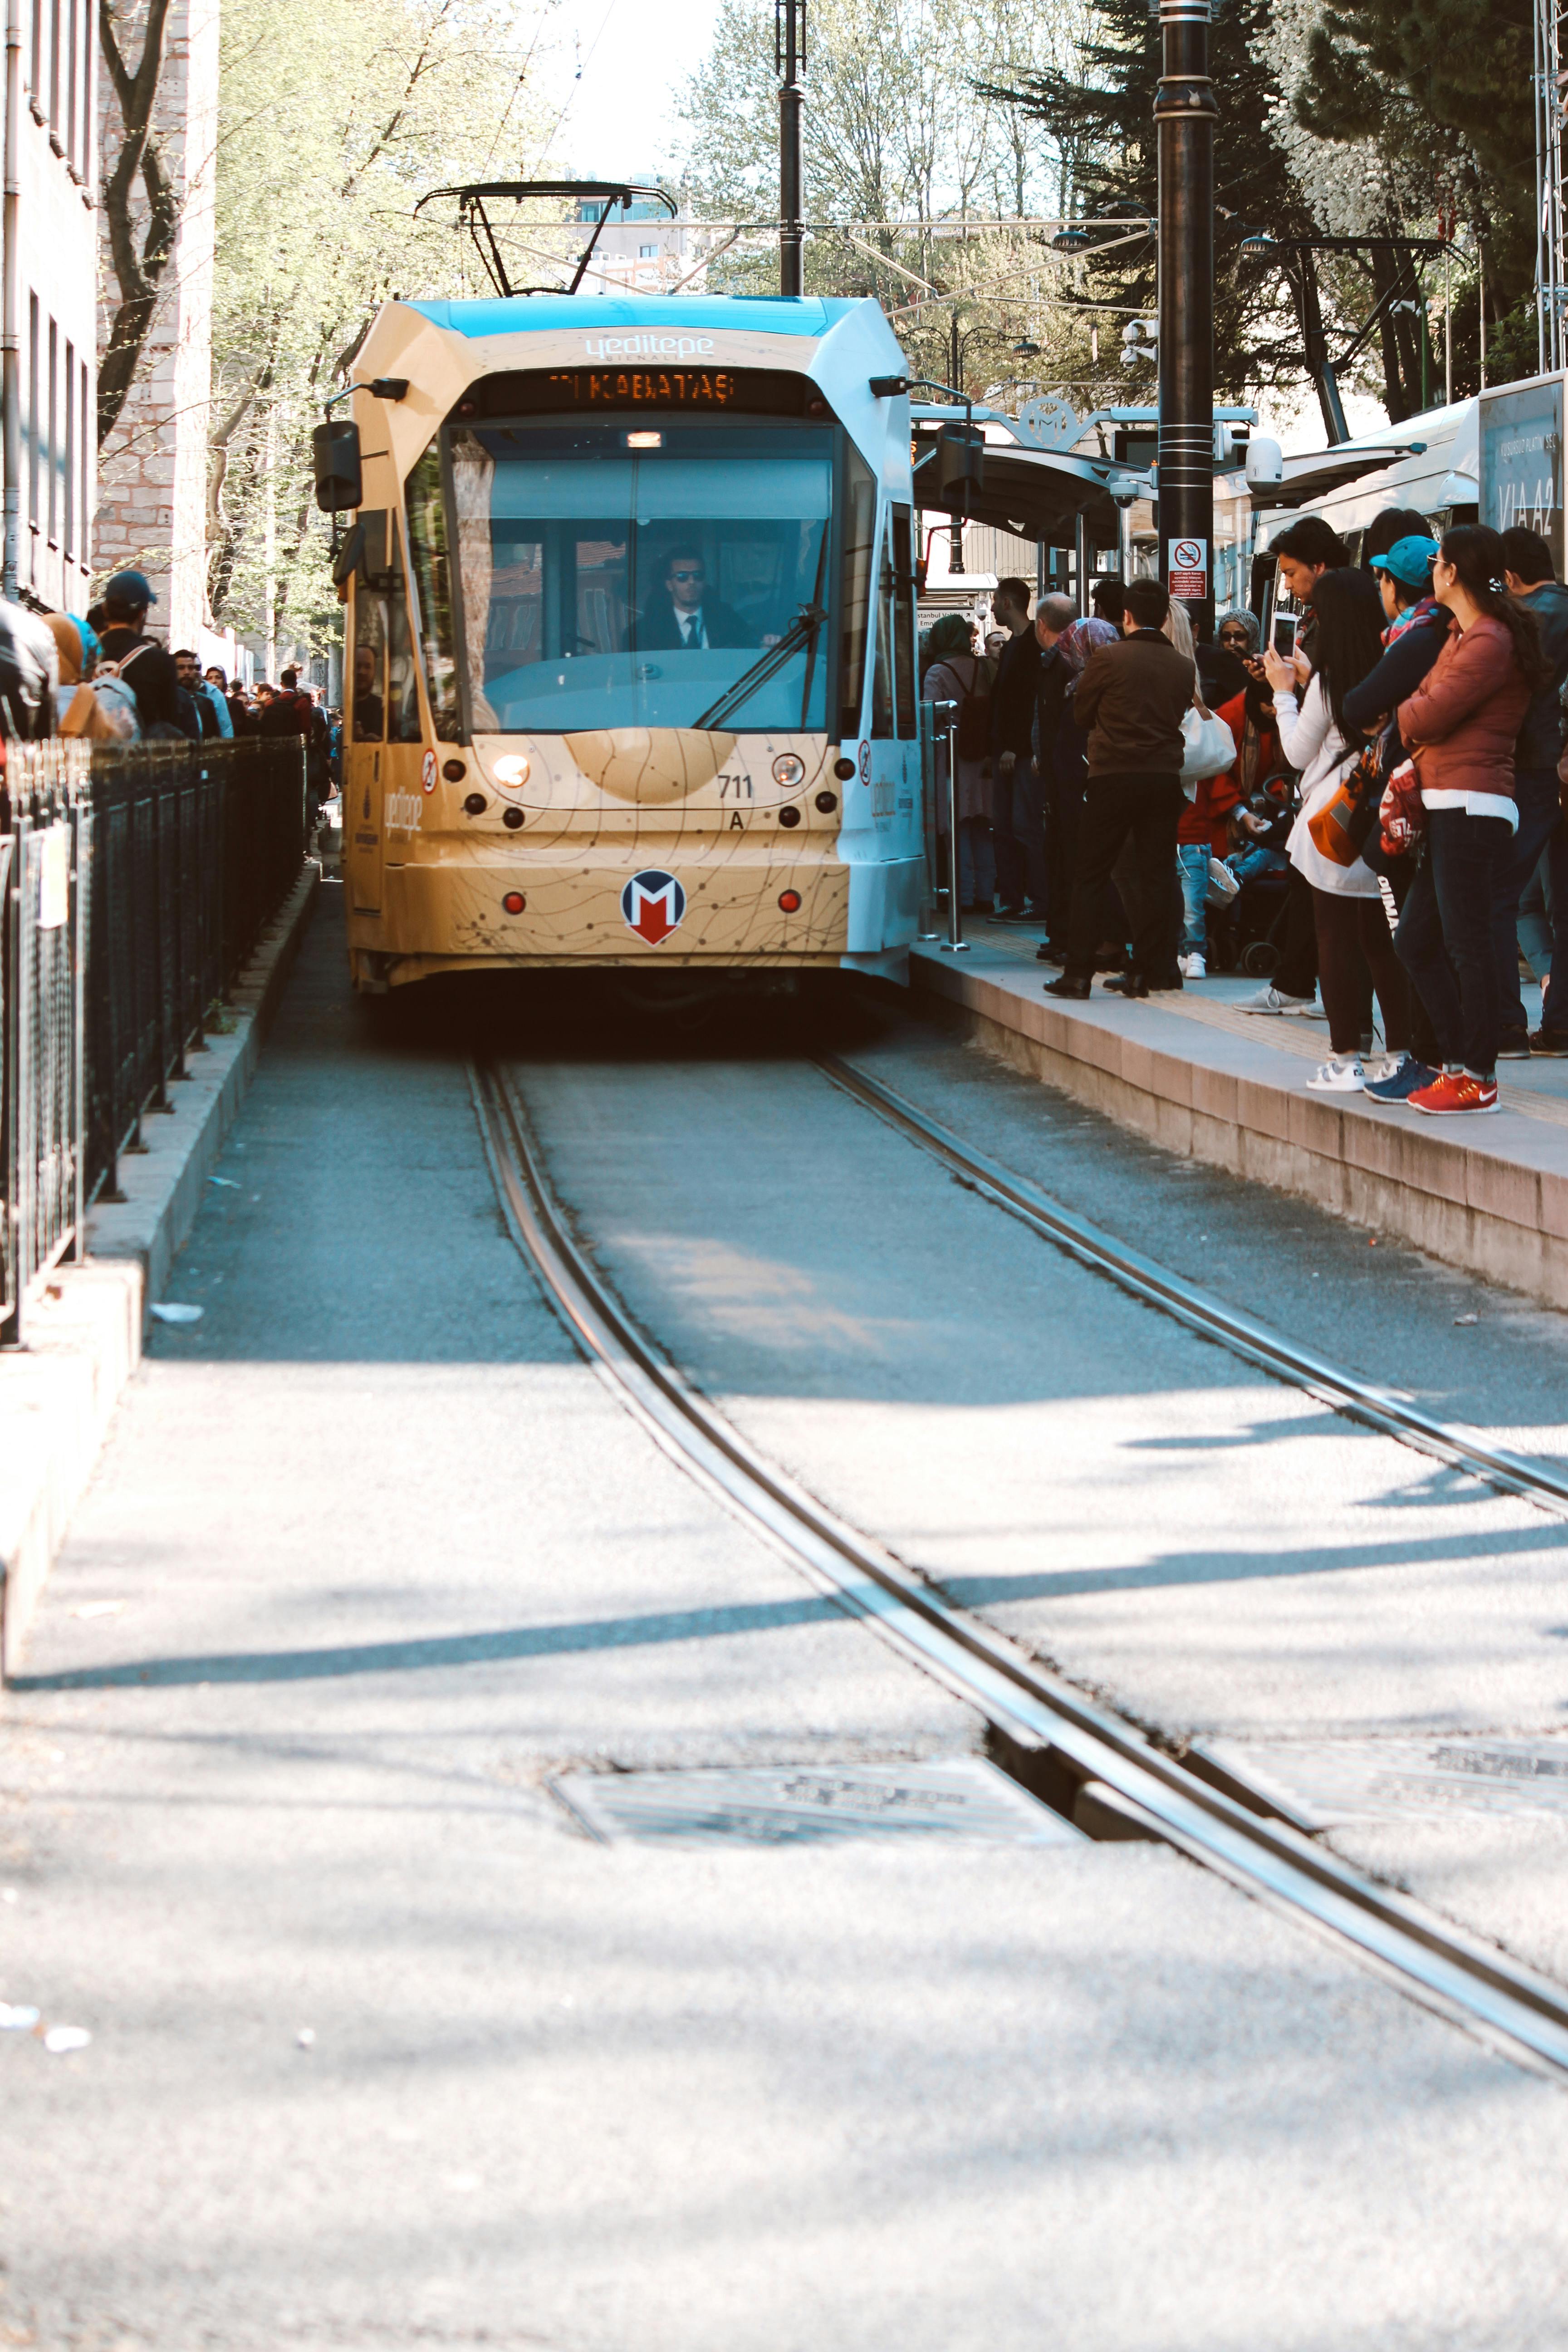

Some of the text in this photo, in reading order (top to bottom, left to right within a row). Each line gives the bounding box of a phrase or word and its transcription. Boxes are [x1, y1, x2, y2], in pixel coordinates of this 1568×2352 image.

[586, 335, 714, 359] yeditepe
[718, 774, 752, 799] 711
[730, 811, 744, 829] A
